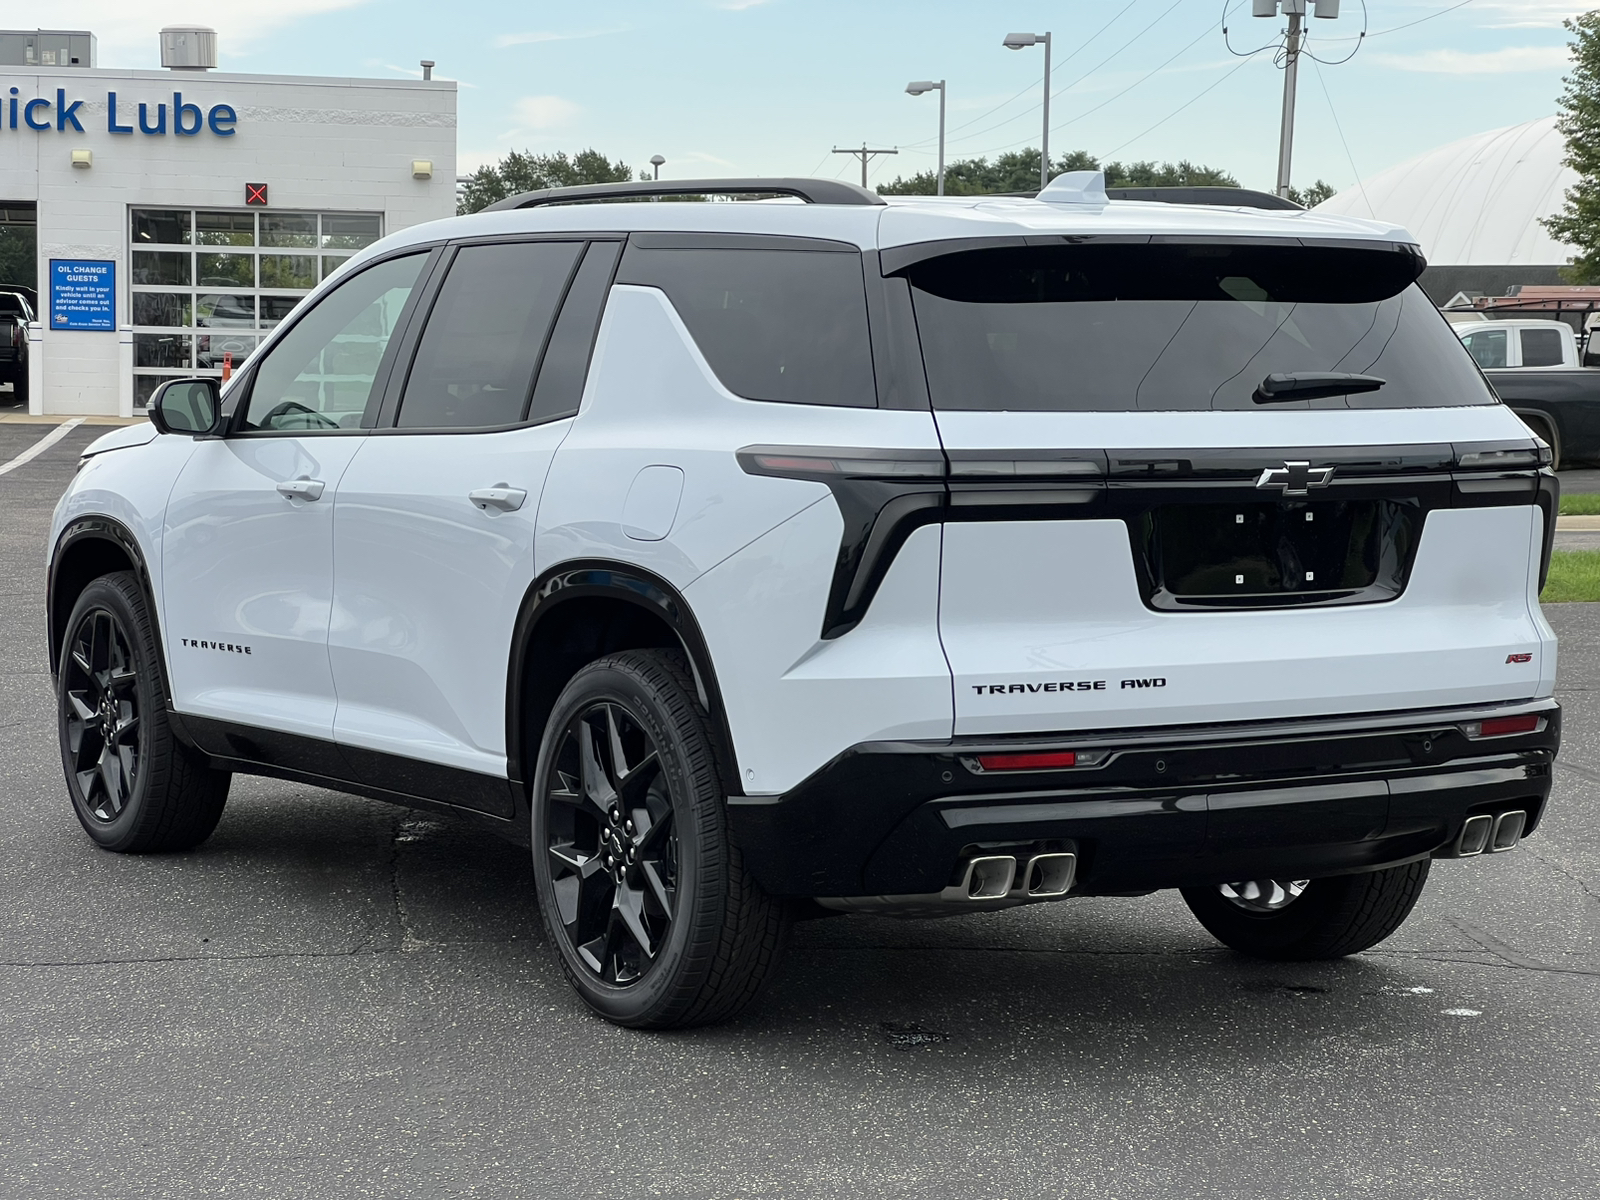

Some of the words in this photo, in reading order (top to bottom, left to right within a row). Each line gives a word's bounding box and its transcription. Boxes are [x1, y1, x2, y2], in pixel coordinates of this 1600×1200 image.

[0, 87, 86, 133] ick
[107, 91, 237, 136] Lube
[57, 265, 71, 273] OIL
[73, 266, 107, 274] CHANGE
[66, 274, 99, 282] GUESTS
[181, 638, 252, 655] TRAVERSE
[1505, 652, 1532, 664] RS
[971, 680, 1107, 695] TRAVERSE
[1120, 677, 1166, 690] AWD
